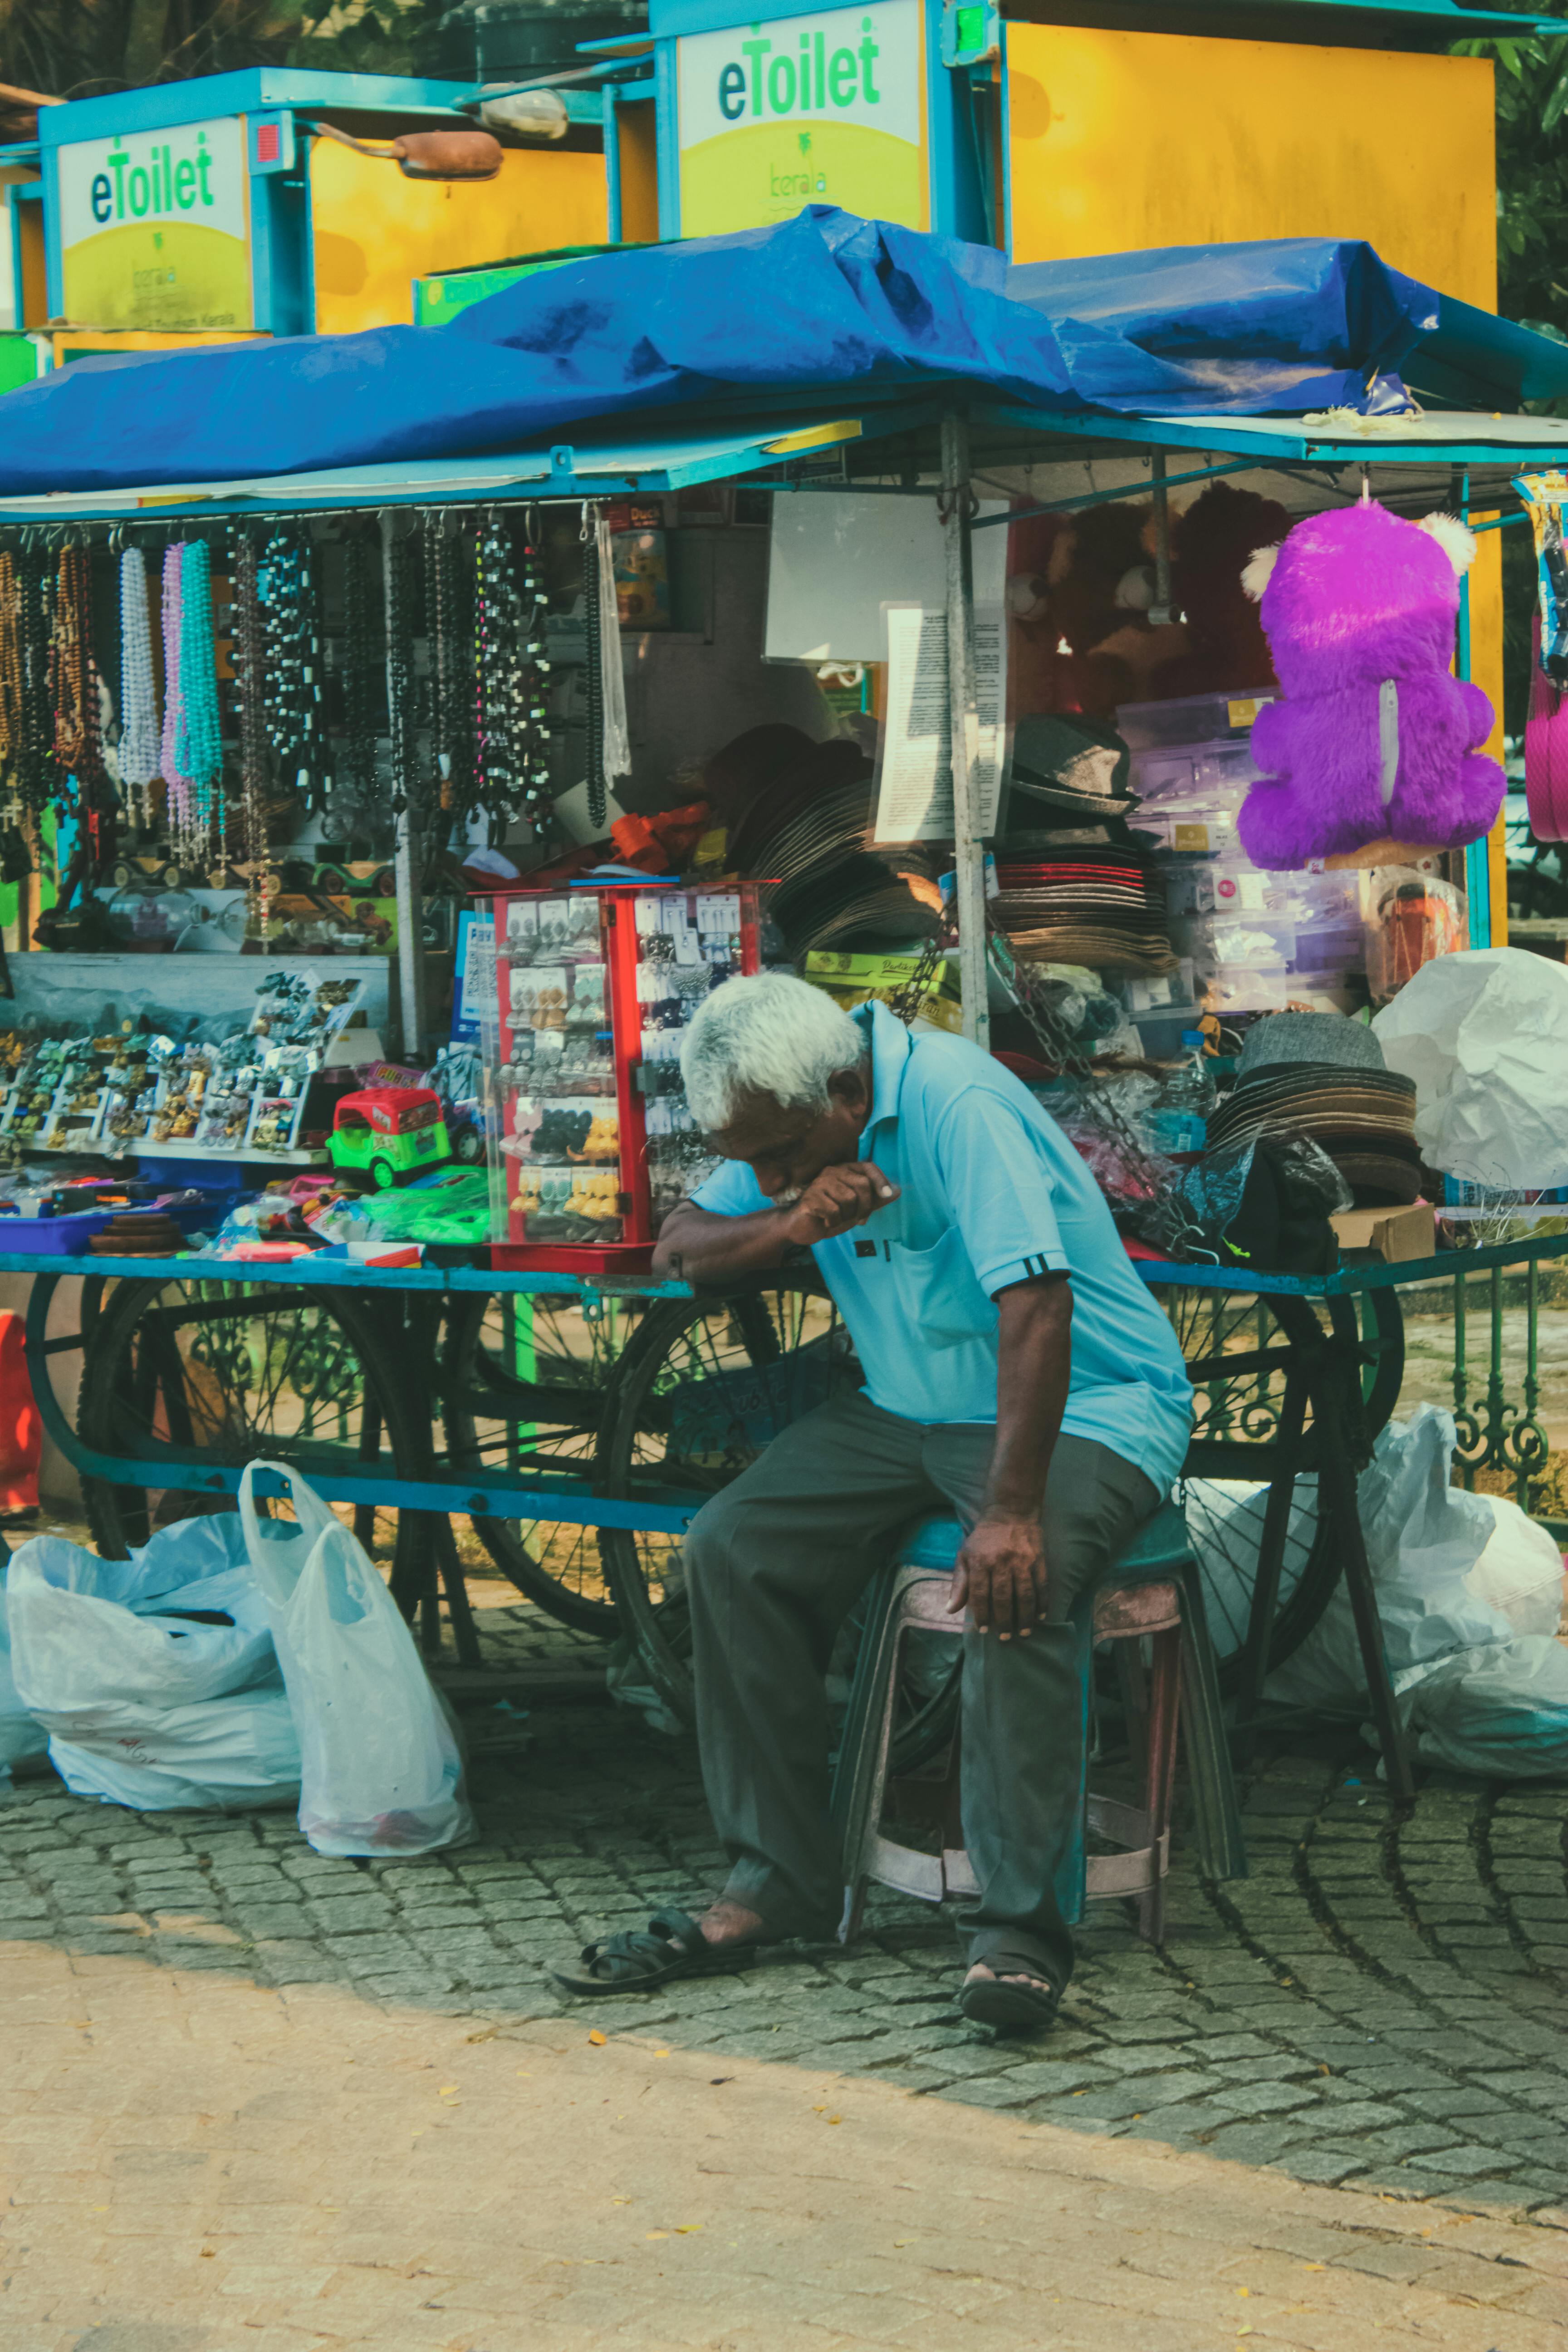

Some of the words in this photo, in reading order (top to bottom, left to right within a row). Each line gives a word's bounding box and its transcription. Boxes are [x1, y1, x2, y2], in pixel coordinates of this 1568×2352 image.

[719, 17, 880, 120] eToilet
[92, 132, 214, 223] eToilet
[770, 162, 826, 196] kerala
